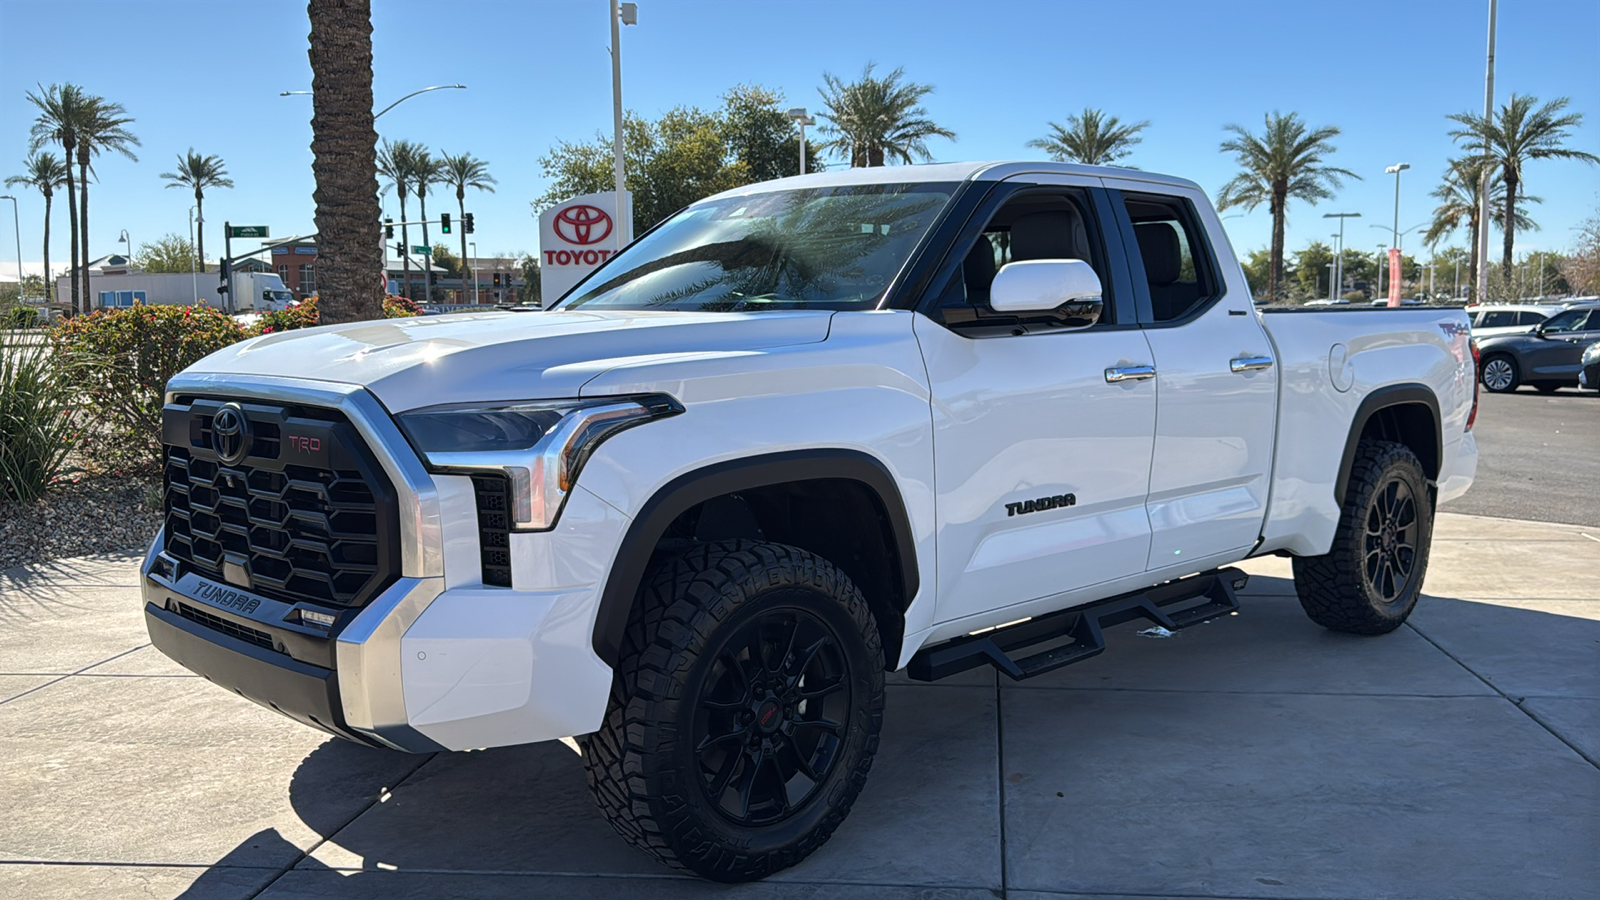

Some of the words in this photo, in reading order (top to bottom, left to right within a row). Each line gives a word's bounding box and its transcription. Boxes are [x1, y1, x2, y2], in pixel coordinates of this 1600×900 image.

[543, 250, 618, 266] TOYOT
[288, 435, 321, 454] TRD
[1005, 493, 1076, 517] TUNDRA
[192, 581, 261, 614] TUNDRA
